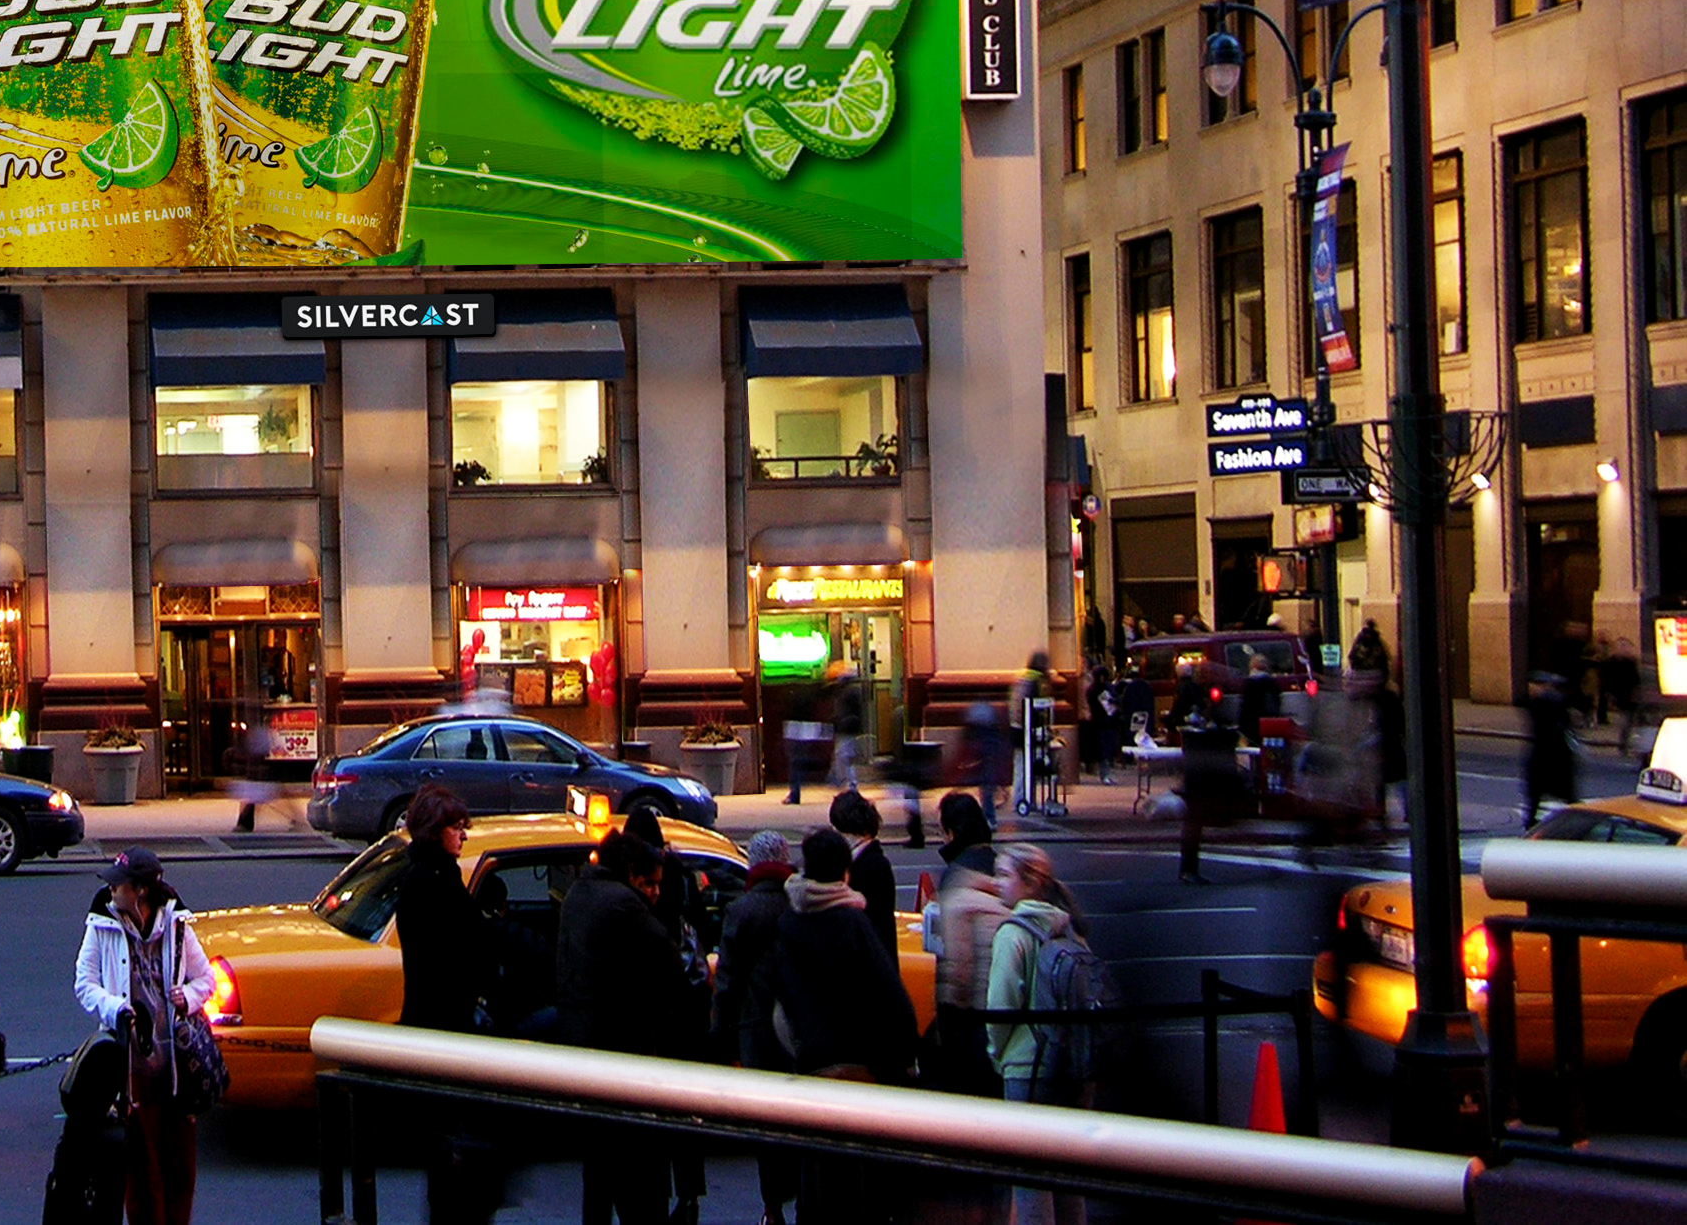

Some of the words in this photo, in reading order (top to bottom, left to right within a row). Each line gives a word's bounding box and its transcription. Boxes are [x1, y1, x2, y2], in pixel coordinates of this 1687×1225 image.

[982, 15, 1001, 87] CLUB
[267, 188, 304, 202] BEER
[9, 203, 55, 221] LIGHT
[60, 198, 102, 215] BEER
[26, 216, 100, 236] NATURAL
[104, 211, 141, 227] LIME
[144, 205, 193, 223] FLAVOR
[301, 207, 332, 222] LIME
[334, 211, 377, 229] FLAVOR
[1212, 408, 1272, 432] Seventh
[1274, 407, 1303, 427] Ave
[1215, 447, 1272, 470] Fashion
[1274, 445, 1303, 467] Ave
[1300, 478, 1323, 490] ONE
